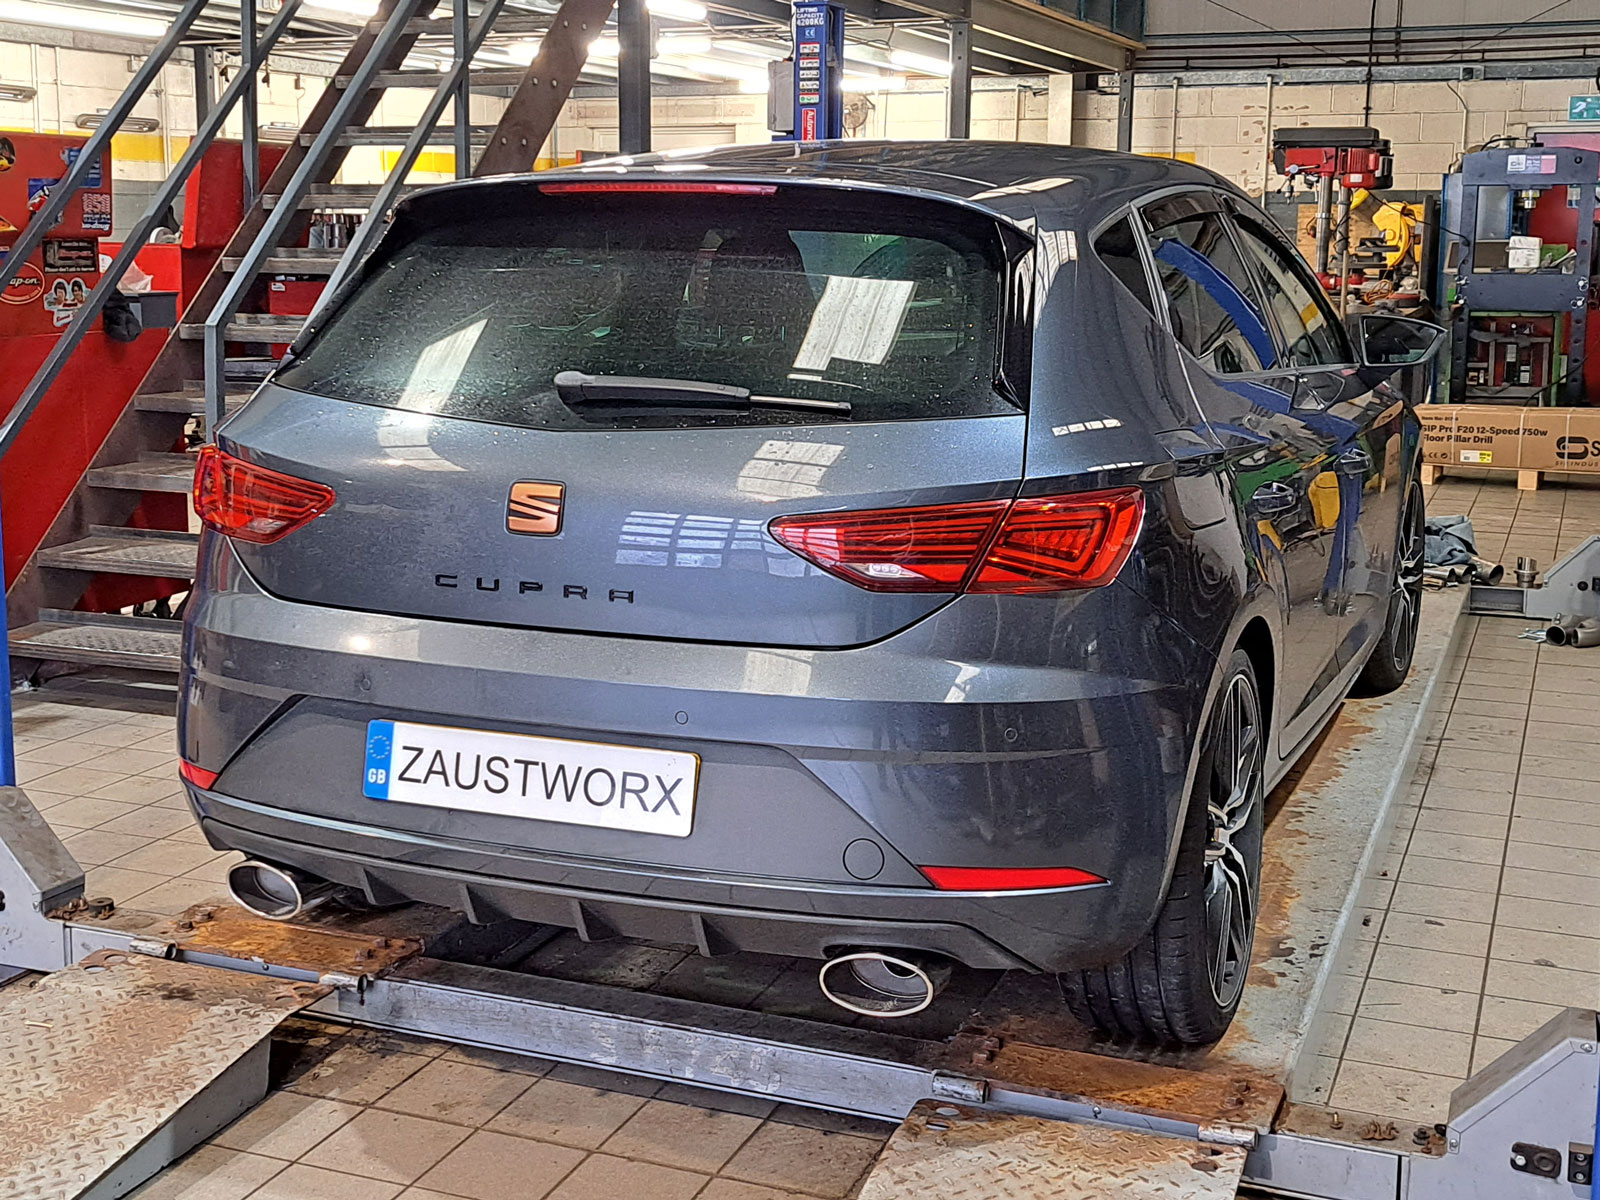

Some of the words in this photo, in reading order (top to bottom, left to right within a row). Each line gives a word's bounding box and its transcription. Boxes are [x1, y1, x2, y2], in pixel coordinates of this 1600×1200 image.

[796, 18, 824, 26] 4200KG
[1457, 426, 1475, 434] F20
[1476, 426, 1520, 437] 12-Speed
[1521, 427, 1548, 437] 750w
[1473, 435, 1493, 444] Drill
[434, 574, 635, 604] CUPRA
[367, 769, 386, 784] GB
[397, 745, 684, 816] ZAUSTWORX
